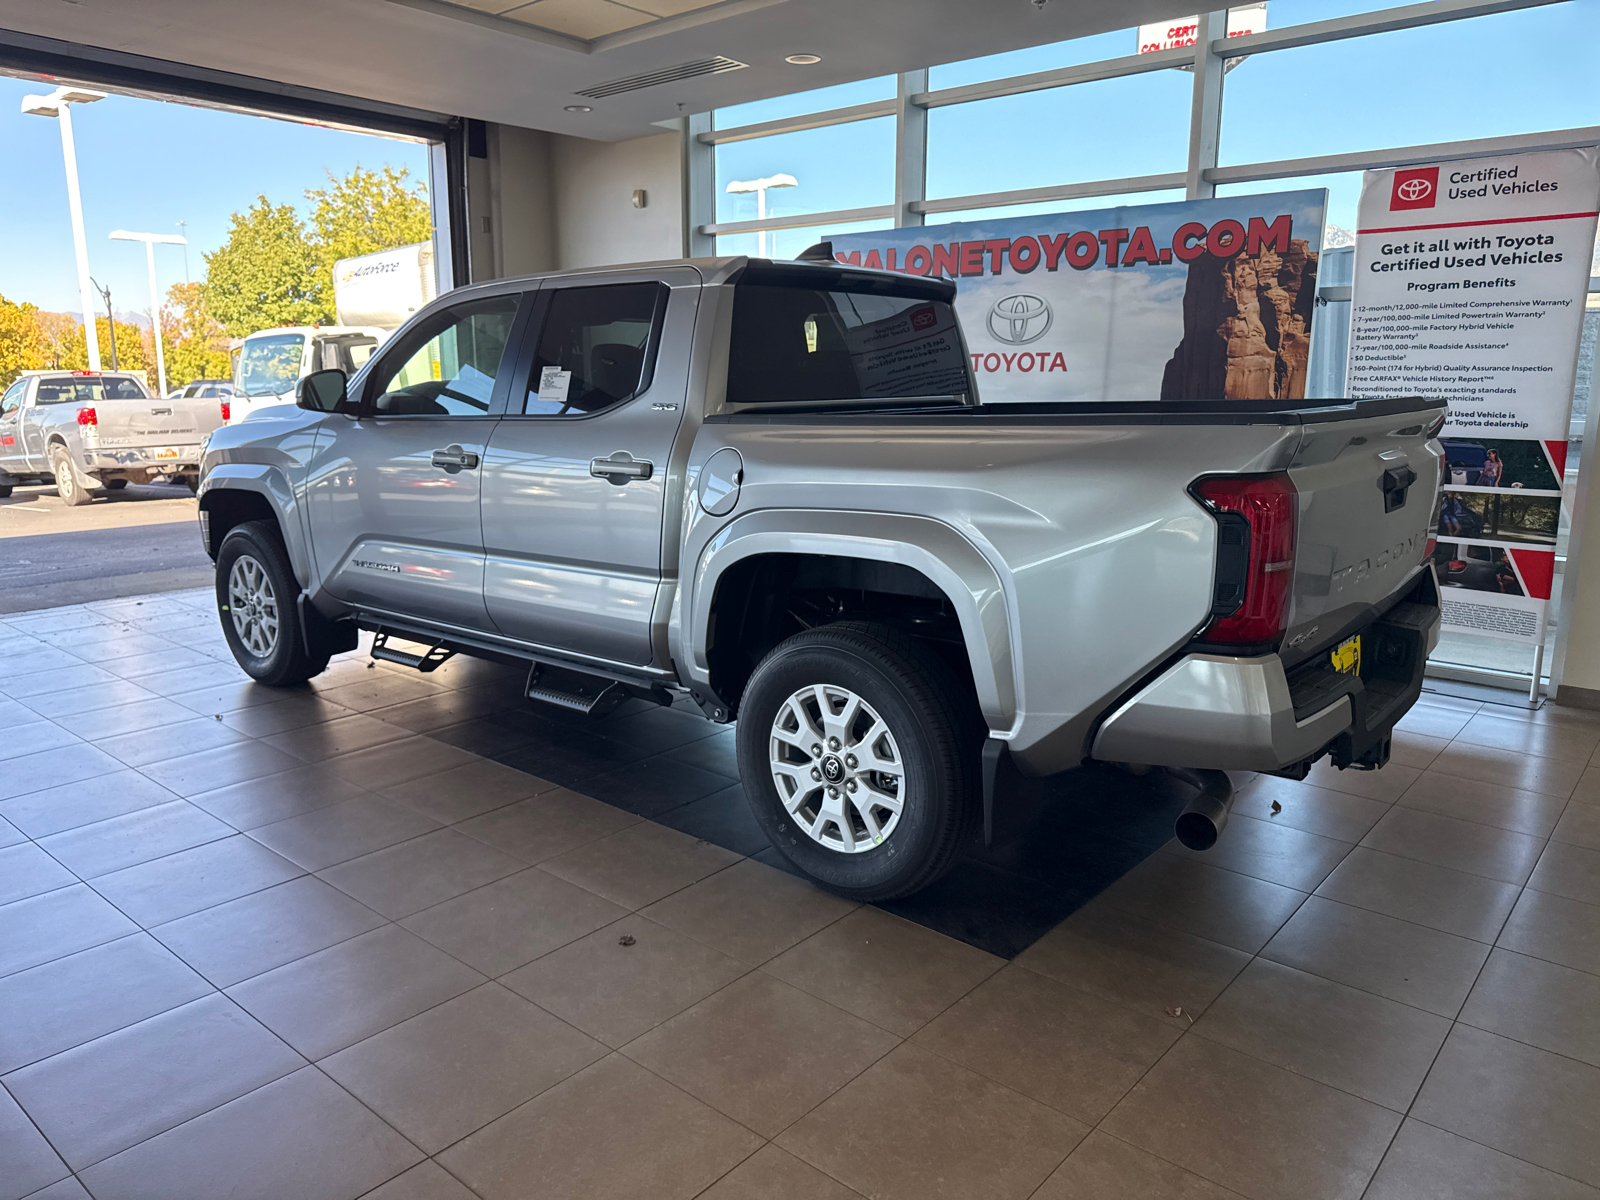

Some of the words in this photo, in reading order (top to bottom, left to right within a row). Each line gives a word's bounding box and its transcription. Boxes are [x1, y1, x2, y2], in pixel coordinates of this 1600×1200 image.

[1167, 24, 1198, 39] CERT
[1450, 166, 1518, 184] Certified
[1448, 185, 1487, 200] Used
[1492, 180, 1558, 196] Vehicles
[1381, 243, 1410, 256] Get
[1414, 241, 1424, 254] it
[1429, 238, 1449, 253] all
[1454, 236, 1491, 251] with
[1496, 233, 1554, 251] Toyota
[1370, 255, 1440, 273] Certified
[1444, 254, 1486, 269] Used
[1490, 250, 1563, 266] Vehicles
[1407, 280, 1460, 292] Program
[1463, 277, 1516, 290] Benefits
[1358, 303, 1438, 312] 12-month/12,000-mile
[1470, 300, 1530, 308] Comprehensive
[1357, 314, 1430, 323] 7-year/100,000-mile
[1356, 325, 1428, 333] 8-year/100,000-mile
[1355, 344, 1428, 352] 7-year/100,000-mile
[970, 352, 1068, 373] TOYOTA
[1483, 420, 1529, 429] dealership
